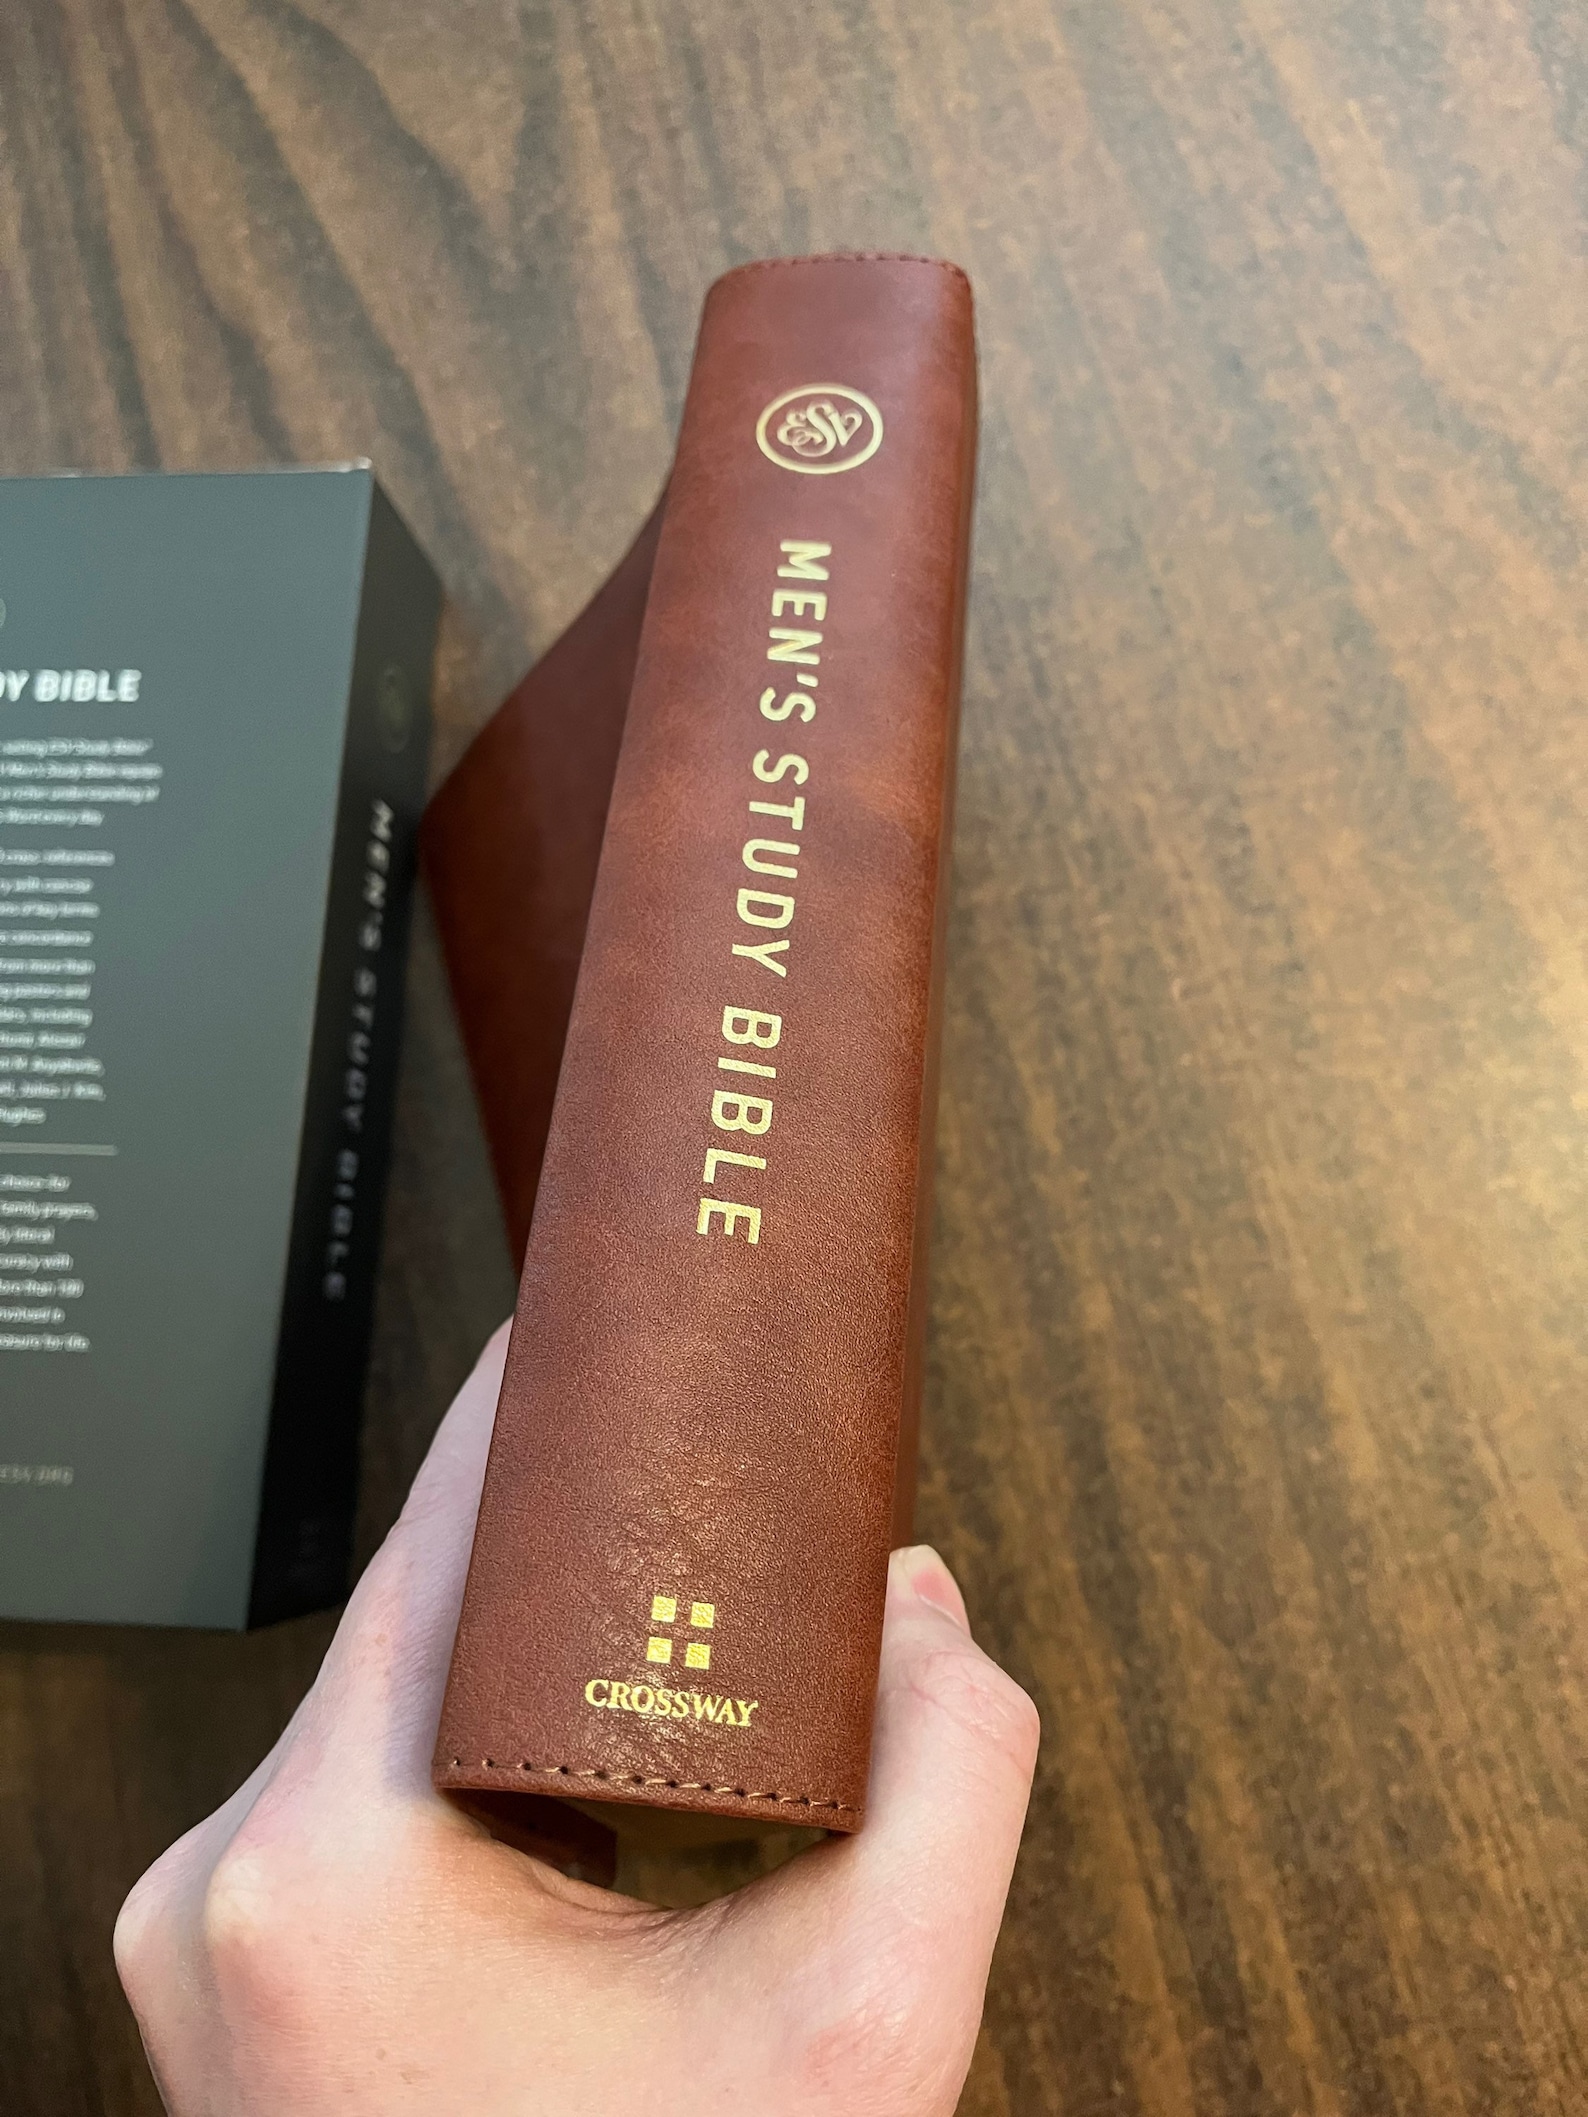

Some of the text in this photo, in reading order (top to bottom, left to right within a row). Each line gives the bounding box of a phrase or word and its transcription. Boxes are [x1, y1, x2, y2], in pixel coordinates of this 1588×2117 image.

[34, 668, 142, 702] BIBLE
[695, 538, 833, 1246] MEN'S STUDY BIBLE
[584, 1678, 759, 1727] CROSSWAY
